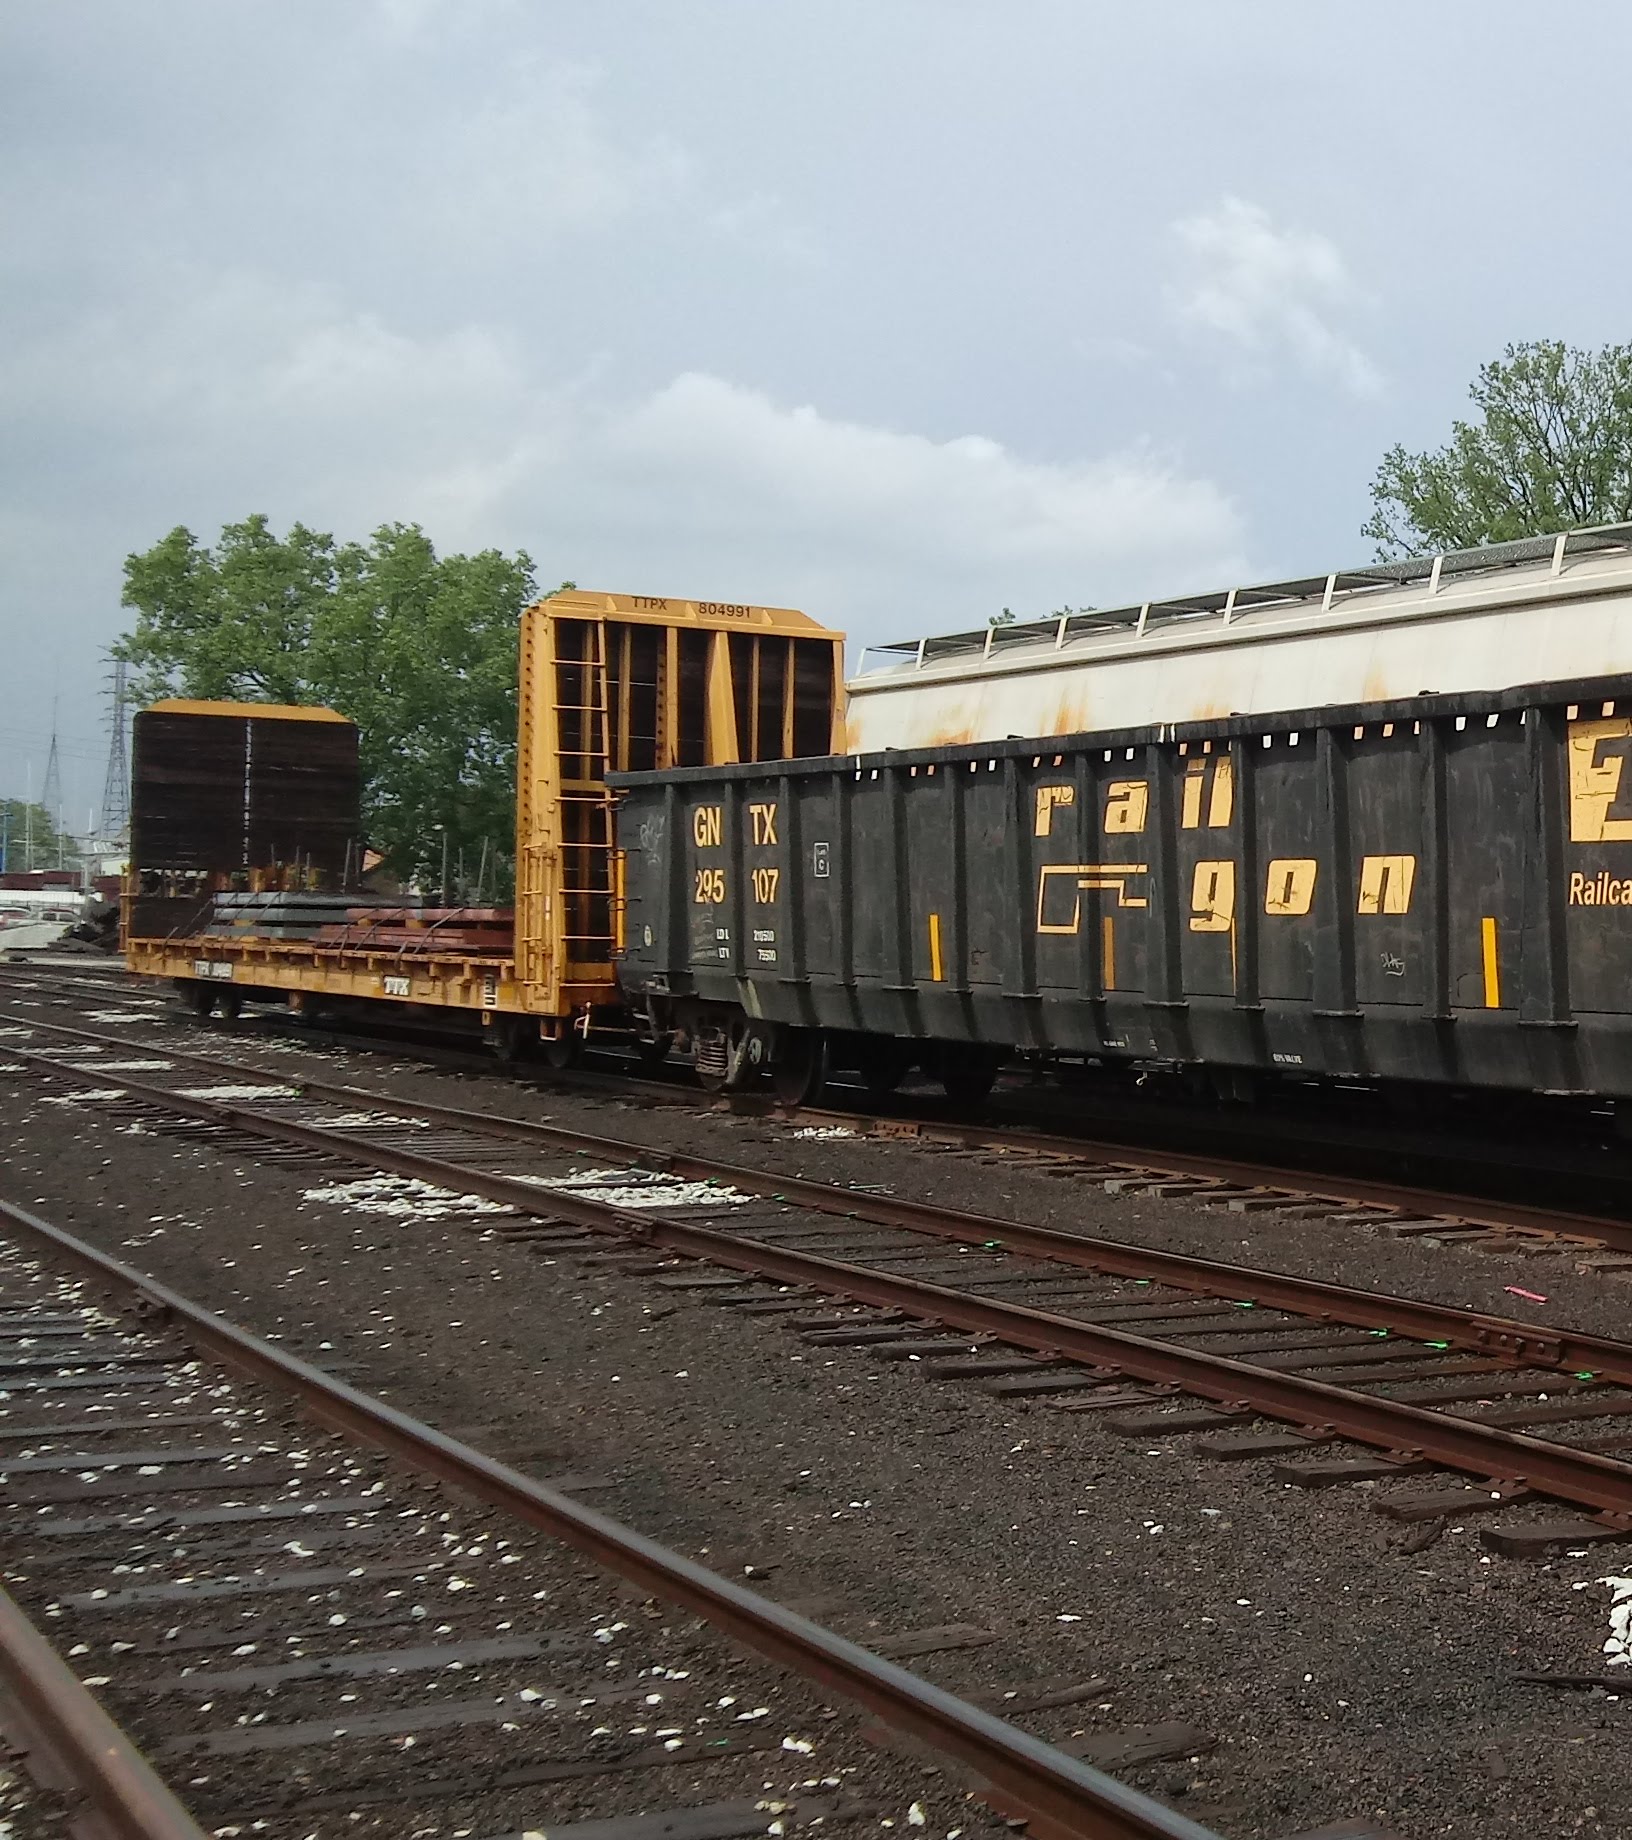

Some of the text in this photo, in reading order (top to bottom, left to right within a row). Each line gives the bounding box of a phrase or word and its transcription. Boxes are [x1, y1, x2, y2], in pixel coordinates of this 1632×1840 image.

[632, 596, 750, 618] TTPX 804991
[1034, 756, 1234, 837] rail
[694, 806, 721, 848] GN
[750, 803, 778, 845] TX
[695, 868, 779, 904] 295 107
[1189, 855, 1415, 932] gon
